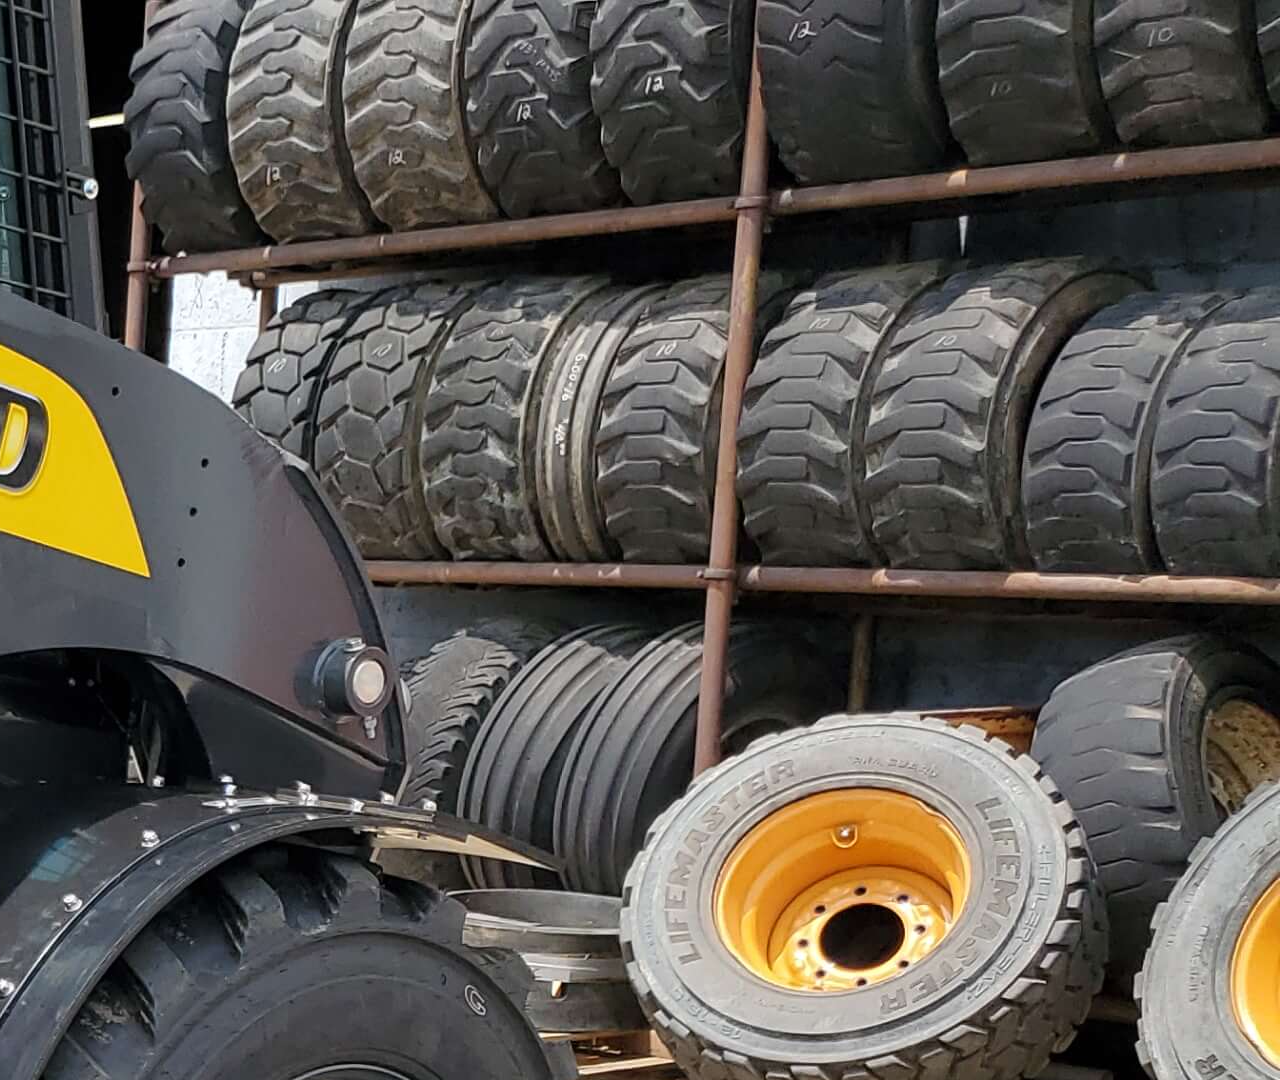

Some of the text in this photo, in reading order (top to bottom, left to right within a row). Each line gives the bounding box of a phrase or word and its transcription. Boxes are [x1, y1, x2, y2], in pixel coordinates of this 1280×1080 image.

[789, 20, 817, 42] 12
[1147, 26, 1175, 47] 10
[645, 76, 665, 95] 12
[990, 81, 1013, 97] 10
[516, 103, 534, 122] 12
[388, 149, 407, 167] 12
[266, 165, 281, 186] 12
[371, 343, 392, 358] 10
[656, 342, 677, 357] 10
[934, 335, 957, 347] 10
[267, 358, 288, 374] 10
[665, 758, 795, 966] LIFEMASTER
[880, 796, 1022, 1016] LIFEMASTER
